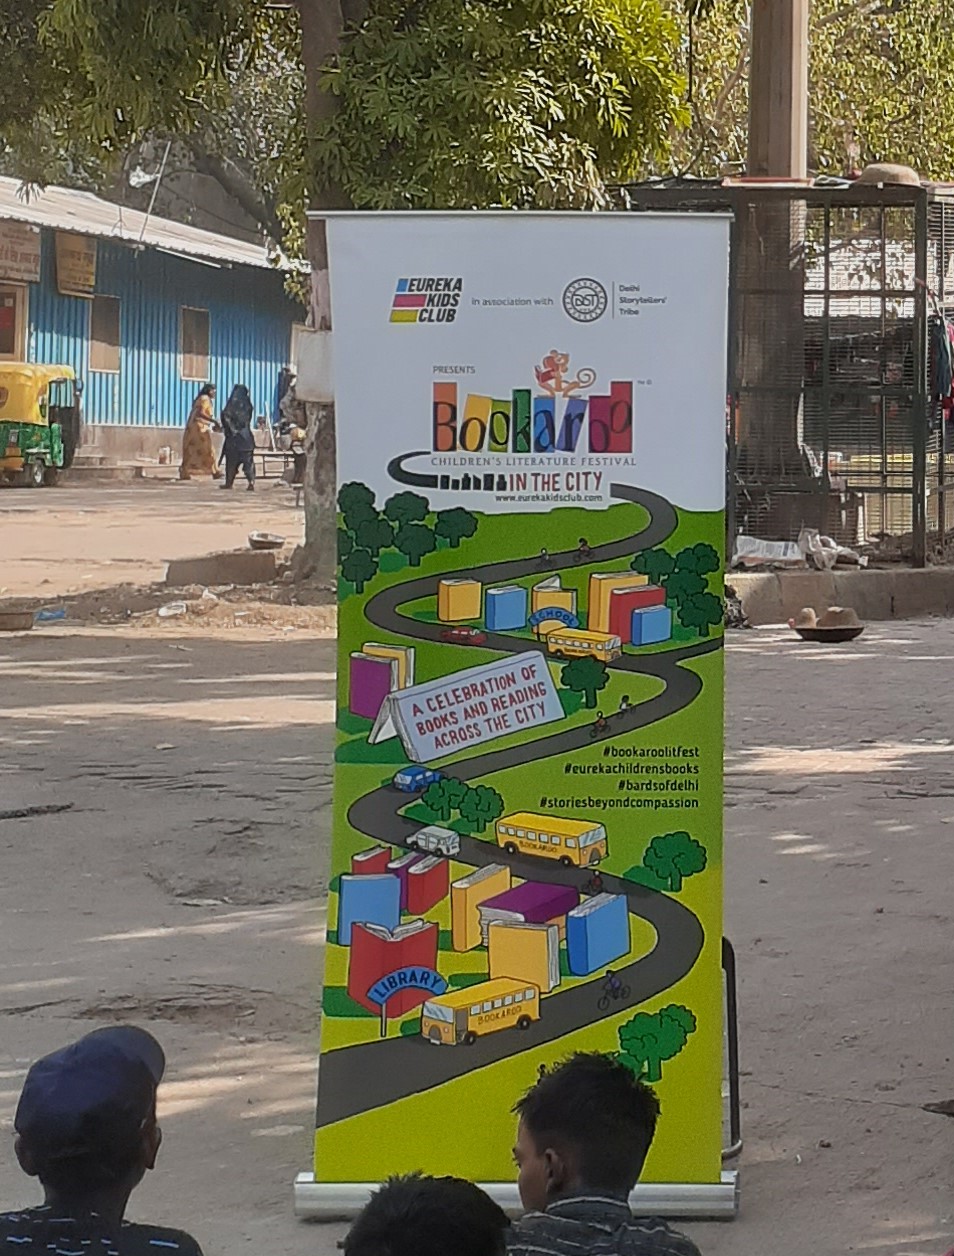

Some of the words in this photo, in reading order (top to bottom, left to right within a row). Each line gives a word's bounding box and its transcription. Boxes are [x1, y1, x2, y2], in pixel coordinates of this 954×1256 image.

[408, 278, 462, 292] EUREKA
[619, 284, 640, 292] Delhi
[427, 293, 460, 307] KIDS
[482, 297, 532, 306] association
[534, 297, 554, 306] with
[418, 308, 457, 322] CLUB
[619, 308, 639, 316] Tribe
[433, 365, 476, 374] PRESENTS
[433, 393, 632, 453] Bookaroo
[431, 457, 502, 467] CHILDREN'S
[506, 457, 576, 466] LITERATURE
[581, 457, 637, 466] FESTIVAL
[509, 473, 527, 491] IN
[531, 473, 560, 491] THE
[566, 471, 602, 491] CITY
[496, 493, 602, 502] www.eurekakidsclub.com
[532, 608, 576, 626] SCHOOL
[412, 703, 424, 717] A
[426, 672, 516, 712] CELEBRATION
[521, 664, 537, 680] OF
[416, 711, 459, 736] BOOKS
[463, 701, 488, 720] AND
[491, 682, 547, 712] READING
[434, 723, 482, 749] ACROSS
[485, 713, 511, 733] THE
[515, 701, 546, 724] CITY
[603, 746, 699, 758] #bookaroolitfest
[564, 762, 699, 775] #eurekachildrensbooks
[618, 780, 699, 792] #bardsofdelhi
[540, 796, 699, 810] #storiesbeyondcompassion
[374, 970, 442, 1000] LIBRARY
[477, 1005, 522, 1025] BOOKAROO
